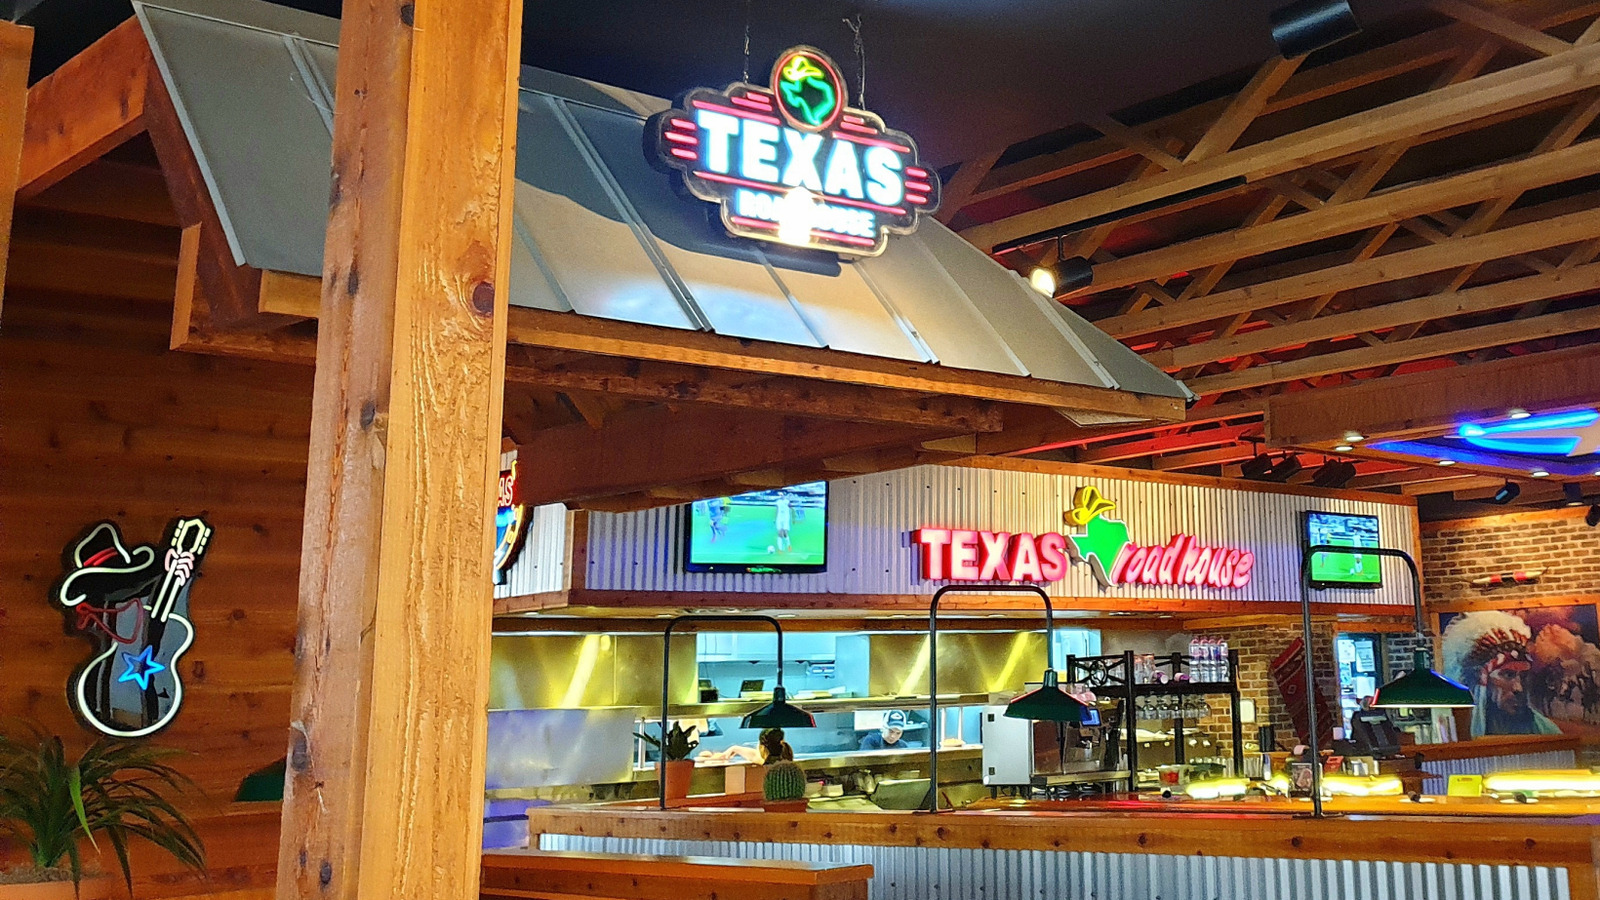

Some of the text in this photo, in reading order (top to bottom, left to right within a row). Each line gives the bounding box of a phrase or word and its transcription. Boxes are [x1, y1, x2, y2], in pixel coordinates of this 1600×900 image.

[697, 109, 904, 206] TEXAS
[736, 188, 875, 238] ROOUSE
[918, 528, 1067, 582] TEXAS
